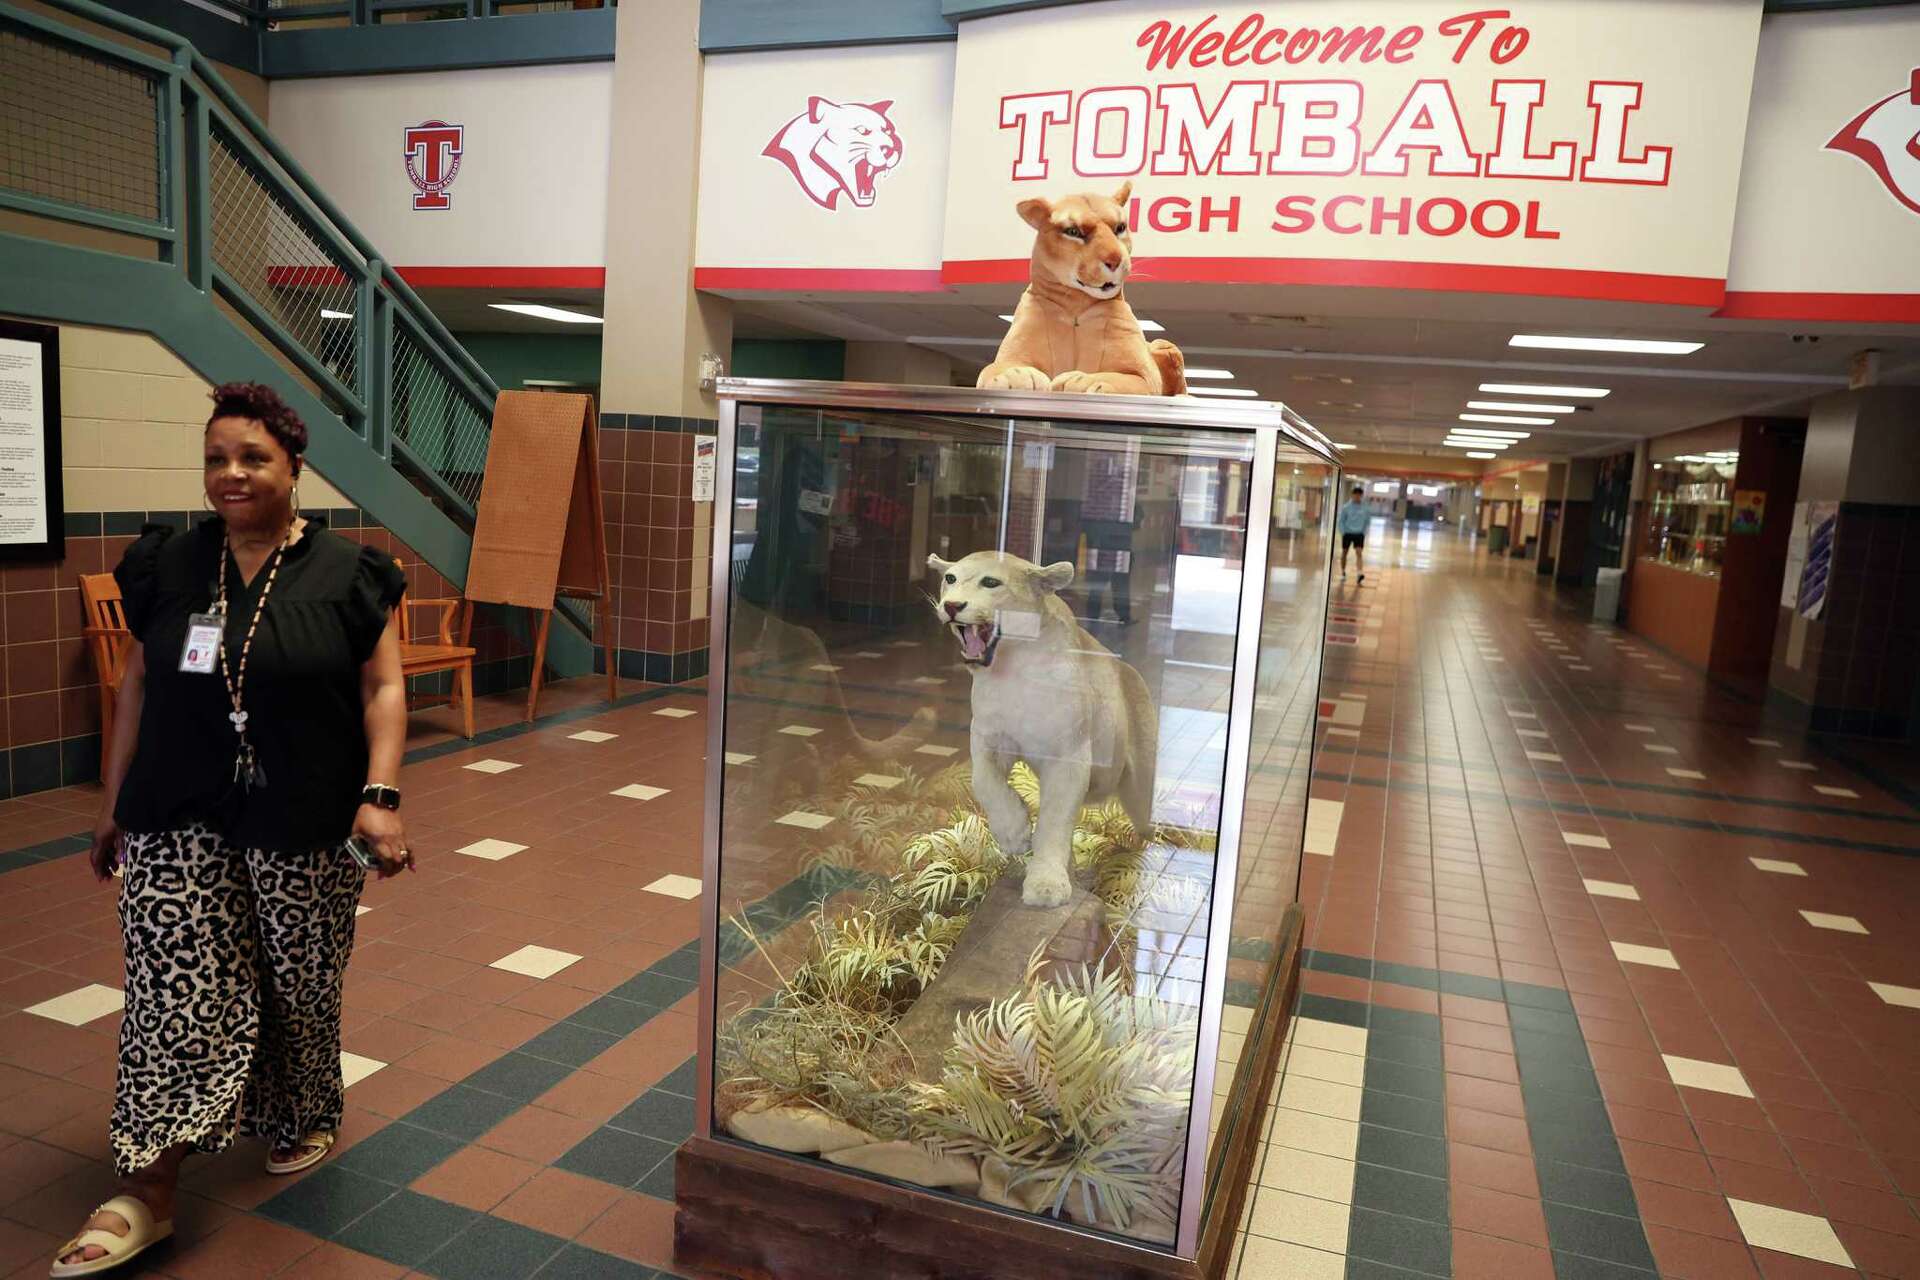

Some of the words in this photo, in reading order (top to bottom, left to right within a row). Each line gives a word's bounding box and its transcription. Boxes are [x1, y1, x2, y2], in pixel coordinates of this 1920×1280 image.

[1136, 12, 1424, 72] Welcome
[1439, 9, 1530, 65] To
[404, 125, 464, 210] T
[999, 79, 1674, 190] TOMBALL
[1127, 195, 1241, 234] IGH
[1272, 195, 1562, 241] SCHOOL
